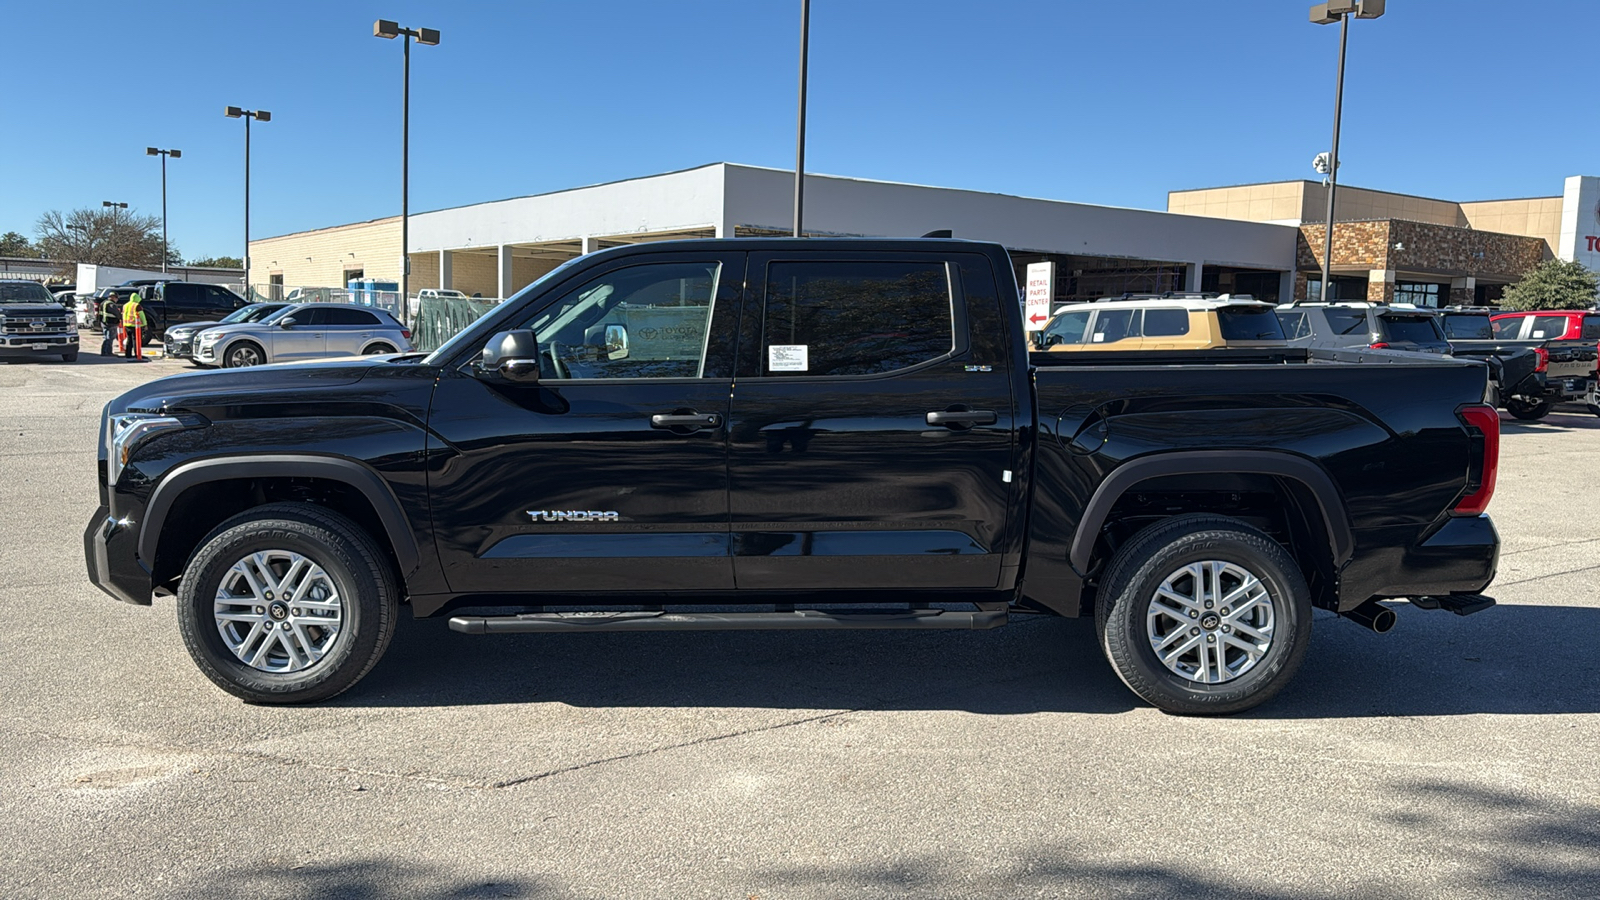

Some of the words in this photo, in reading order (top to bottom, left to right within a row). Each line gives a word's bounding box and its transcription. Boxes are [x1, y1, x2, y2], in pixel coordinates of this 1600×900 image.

[1028, 298, 1048, 306] CENTER
[658, 326, 698, 335] TOYOTA
[526, 510, 619, 522] TUNDRA
